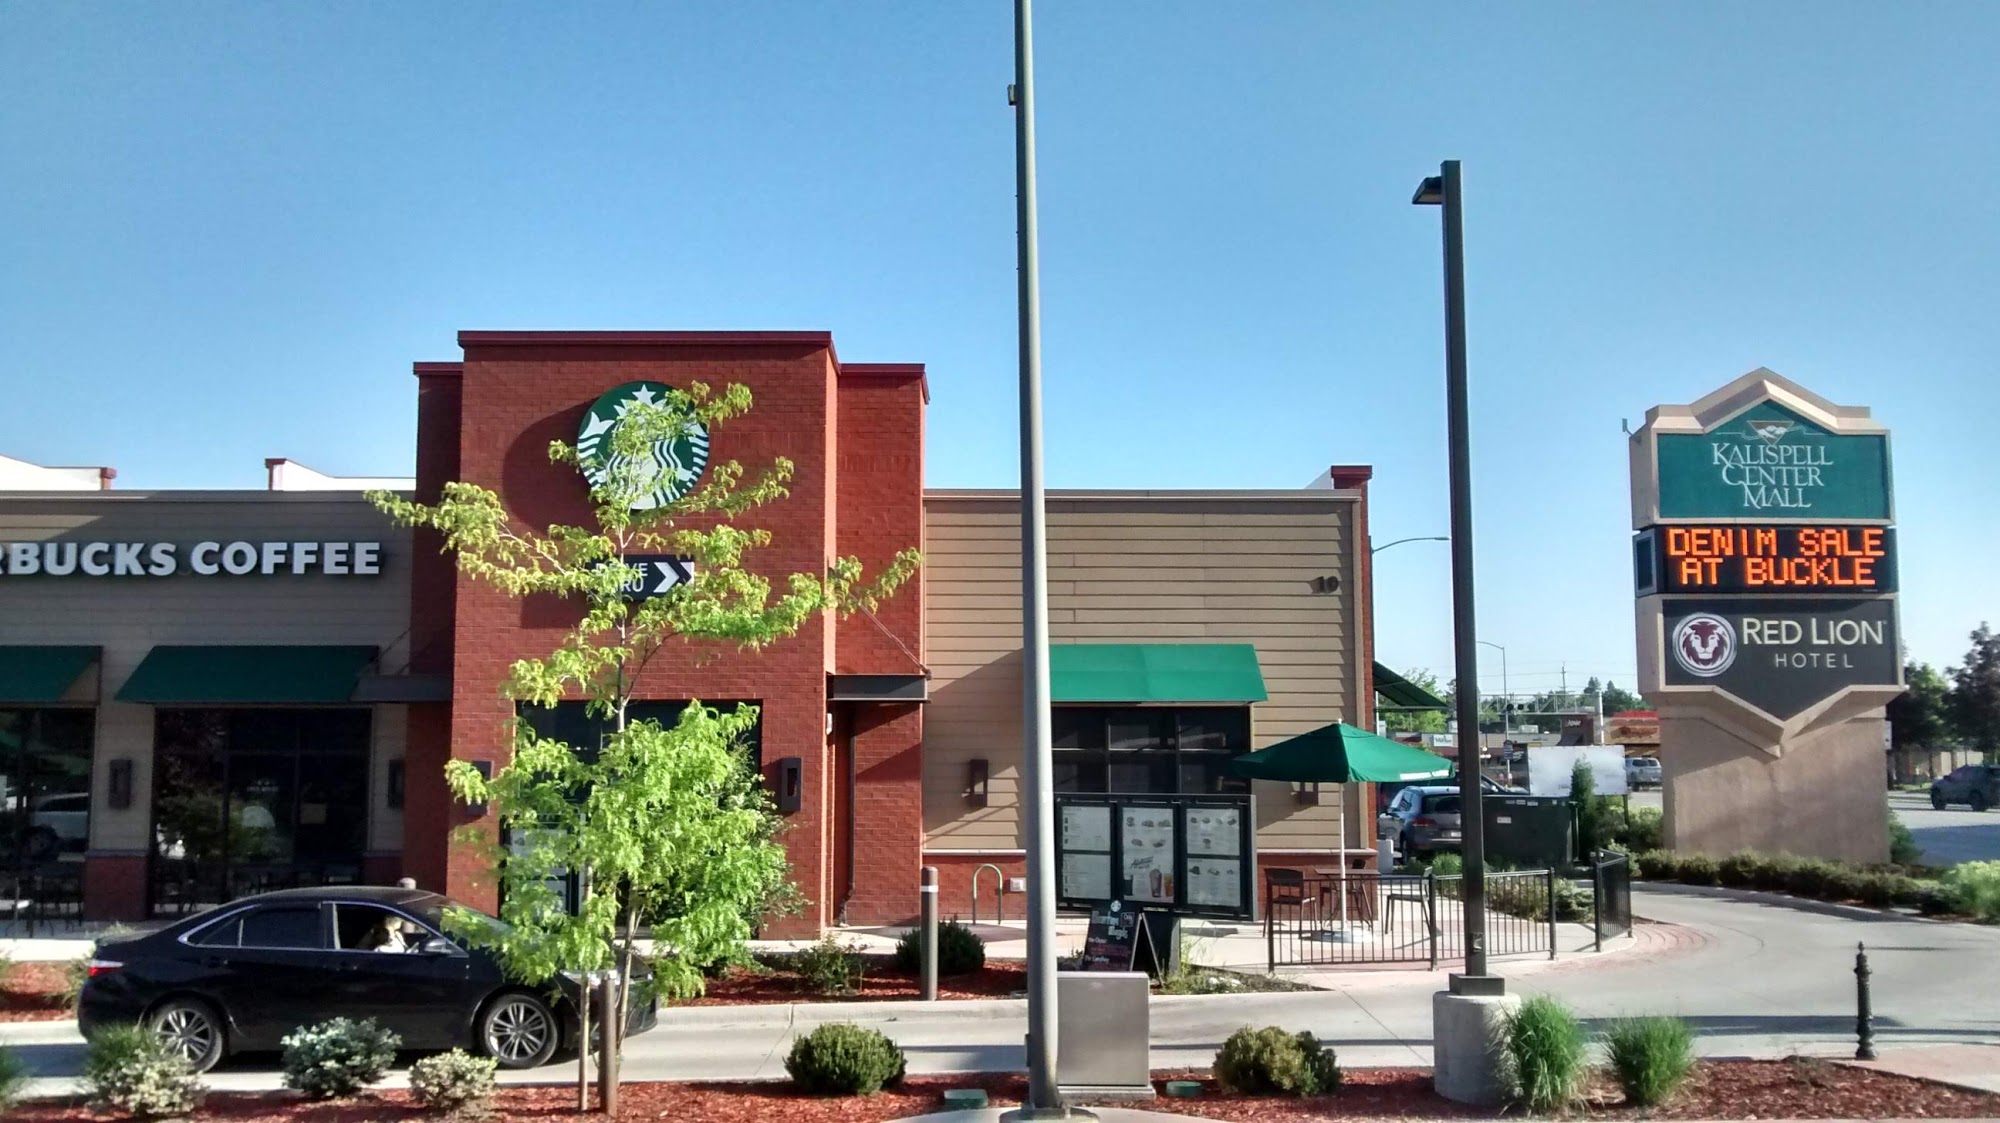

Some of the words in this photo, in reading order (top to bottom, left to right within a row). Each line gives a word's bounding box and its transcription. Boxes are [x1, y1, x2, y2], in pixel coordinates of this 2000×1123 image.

[1711, 442, 1834, 469] KALISPELL
[1721, 462, 1825, 487] CENTER
[1739, 481, 1812, 509] MALL
[1668, 528, 1778, 556] DENIM
[1800, 528, 1886, 556] SALE
[0, 541, 178, 576] BUCKS
[190, 541, 381, 576] COFFEE
[1680, 557, 1724, 585] AT
[1746, 557, 1876, 585] BUCKLE
[1742, 617, 1803, 645] RED
[1811, 617, 1885, 645] LION
[1775, 652, 1854, 669] HOTEL
